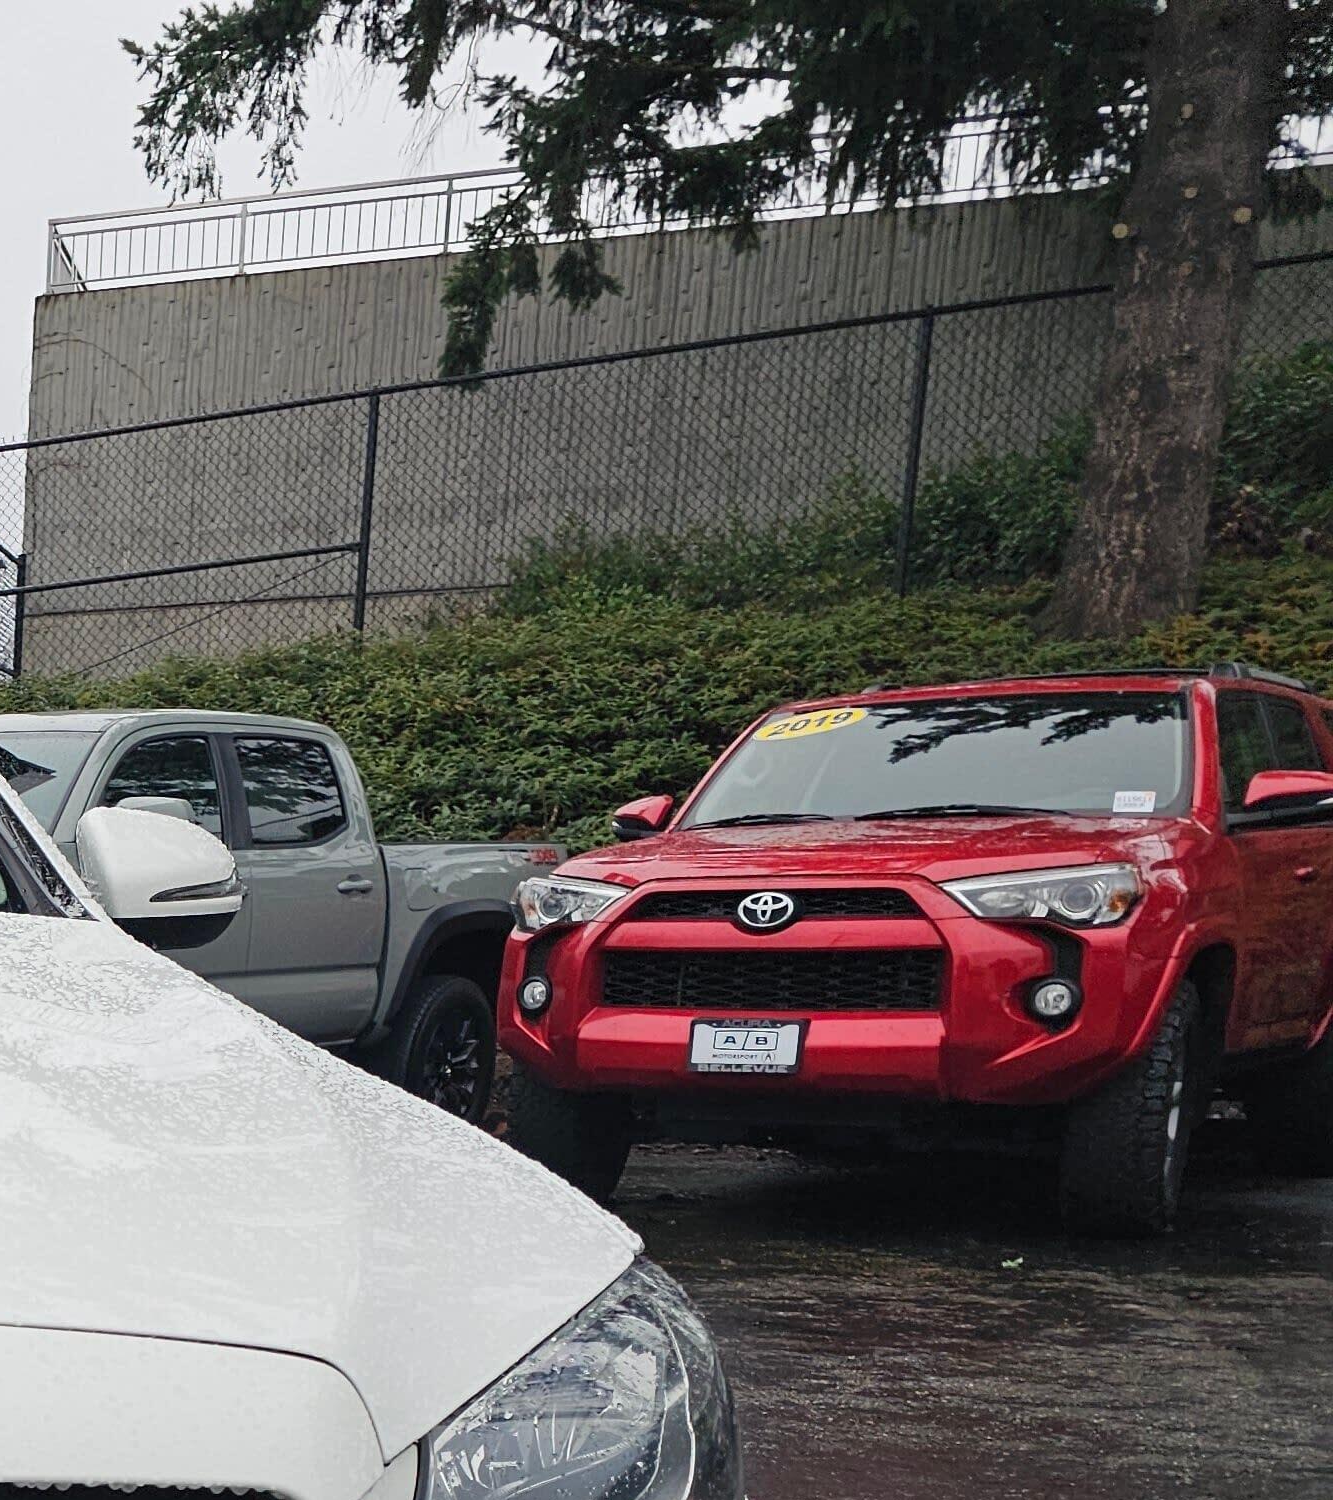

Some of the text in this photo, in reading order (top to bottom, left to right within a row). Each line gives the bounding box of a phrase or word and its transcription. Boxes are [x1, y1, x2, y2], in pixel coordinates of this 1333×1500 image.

[766, 711, 853, 737] 2019
[722, 1019, 772, 1027] ACURA
[724, 1036, 768, 1045] A B
[697, 1063, 788, 1073] BELLEVUE
